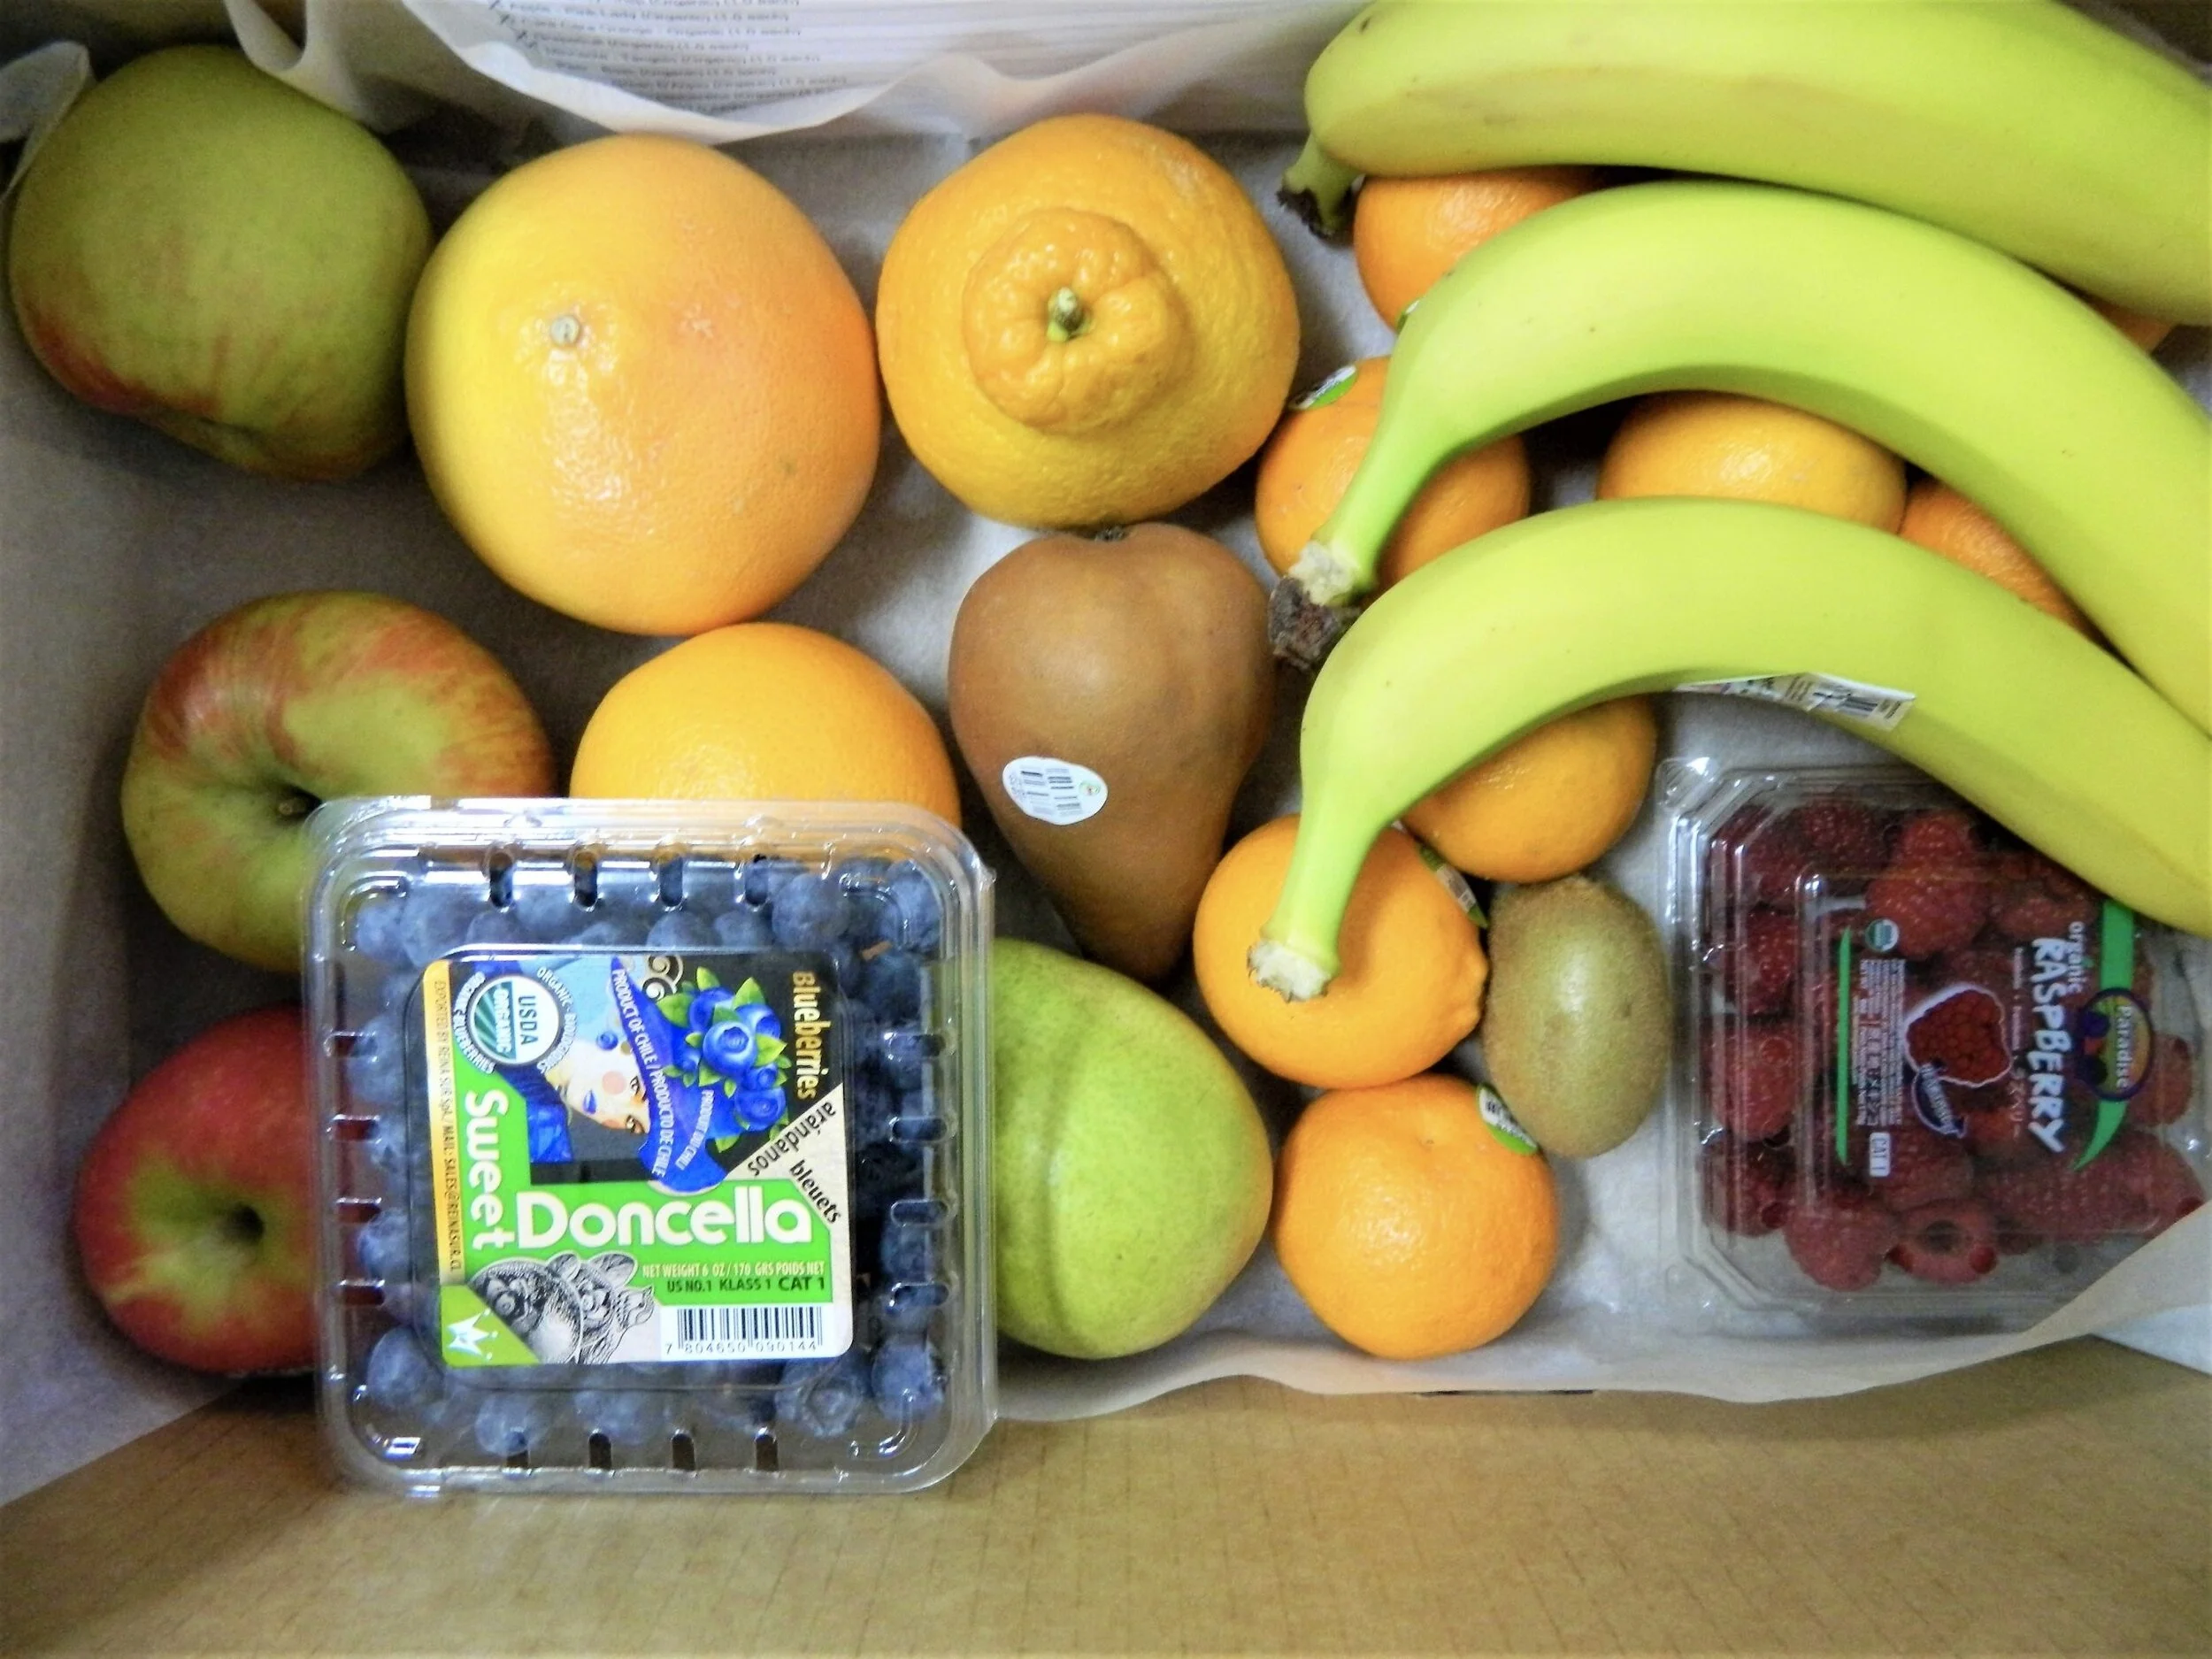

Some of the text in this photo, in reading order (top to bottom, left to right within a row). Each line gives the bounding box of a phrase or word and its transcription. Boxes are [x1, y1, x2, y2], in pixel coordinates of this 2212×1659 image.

[2066, 921, 2088, 994] organic
[537, 966, 573, 1007] ORGANIC
[612, 969, 639, 1019] PRODUCT
[494, 987, 512, 1053] ORGANIC
[518, 995, 538, 1045] USDA
[628, 1018, 645, 1038] OF
[792, 971, 832, 1100] Blueberries
[2026, 937, 2072, 1153] RASPBERRY
[2116, 1005, 2134, 1088] Paradise
[634, 1034, 657, 1069] CHILE
[649, 1068, 674, 1129] PRODUCTO
[651, 1147, 672, 1178] CHILE
[660, 1129, 674, 1147] DE
[748, 1102, 836, 1176] arándanos
[465, 1088, 515, 1249] Sweet
[789, 1159, 841, 1224] bleuets
[516, 1185, 812, 1248] Doncella
[642, 1263, 660, 1278] NET
[661, 1263, 701, 1278] WEIGHT
[702, 1263, 709, 1277] 6
[712, 1263, 725, 1277] OZ
[733, 1263, 751, 1276] 170
[755, 1262, 774, 1276] GRS
[775, 1261, 806, 1276] POIDS
[806, 1261, 826, 1275] NET
[667, 1277, 825, 1294] US NO.1 KLASS 1 CAT 1
[665, 1340, 817, 1355] 7 804650 090144
